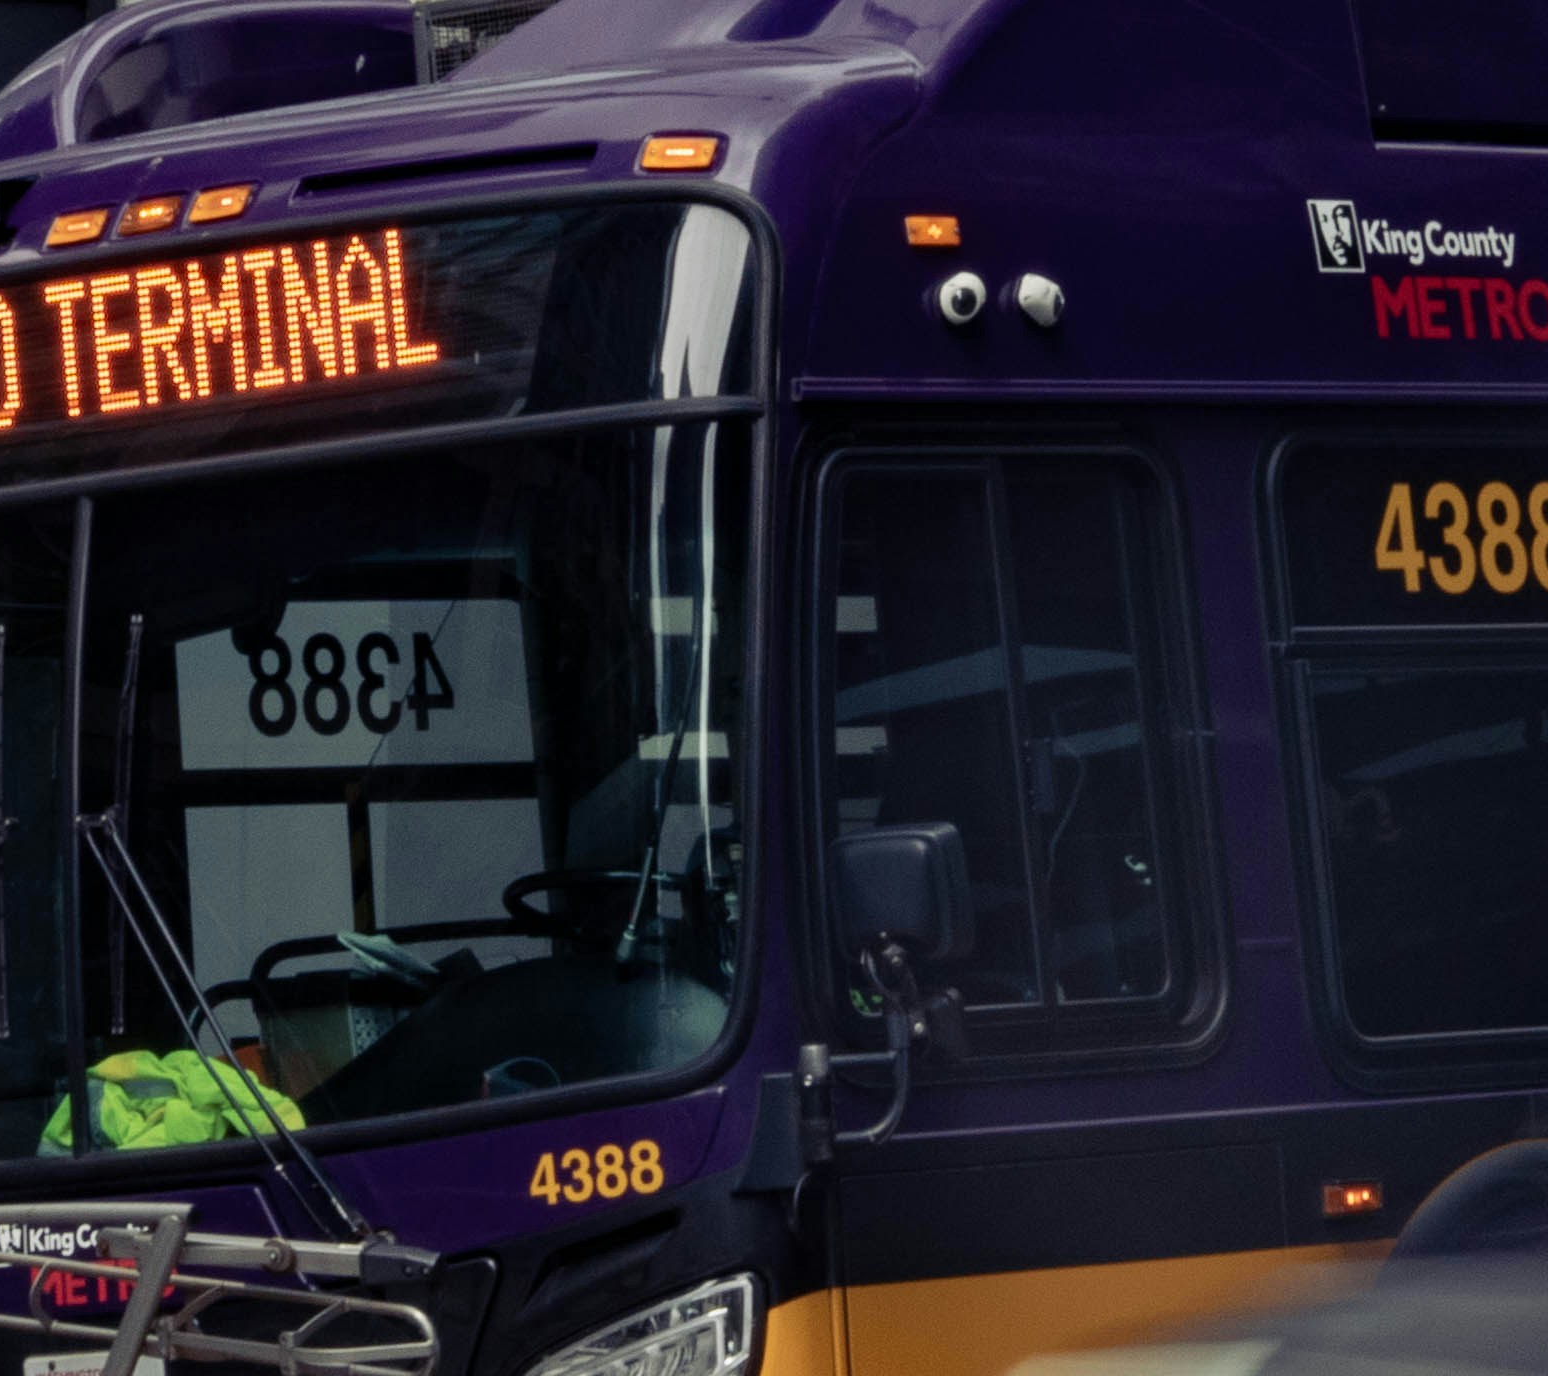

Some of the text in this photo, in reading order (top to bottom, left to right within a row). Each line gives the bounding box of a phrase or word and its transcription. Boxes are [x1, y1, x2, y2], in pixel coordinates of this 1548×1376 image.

[1362, 221, 1515, 267] King County
[45, 229, 440, 418] TERMINAL
[529, 1140, 664, 1205] 4388
[28, 1226, 76, 1257] King
